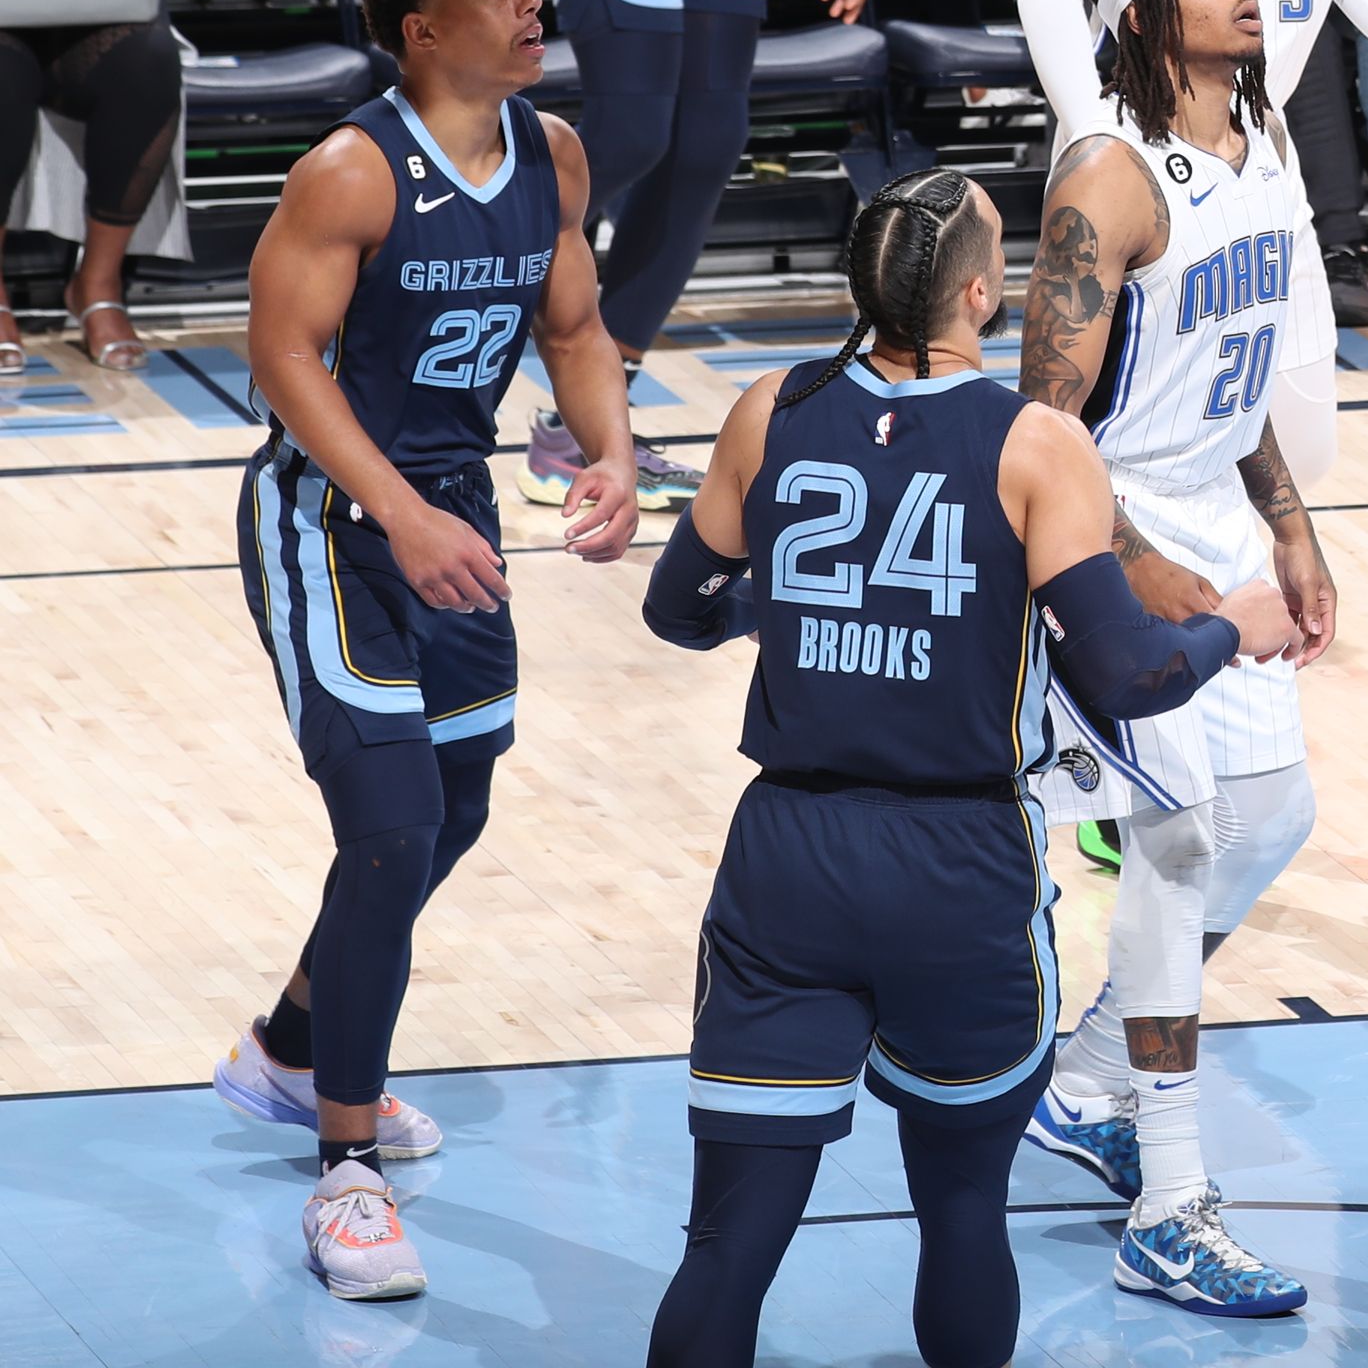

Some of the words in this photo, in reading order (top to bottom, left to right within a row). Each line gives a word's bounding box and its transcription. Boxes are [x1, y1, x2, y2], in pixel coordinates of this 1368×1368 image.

[406, 155, 426, 180] 6
[1170, 157, 1189, 181] 6
[400, 249, 552, 292] GRIZZLIES
[1176, 230, 1294, 336] MAGI
[412, 304, 522, 389] 22
[1203, 323, 1277, 420] 20
[771, 460, 977, 616] 24
[798, 616, 932, 681] BROOKS
